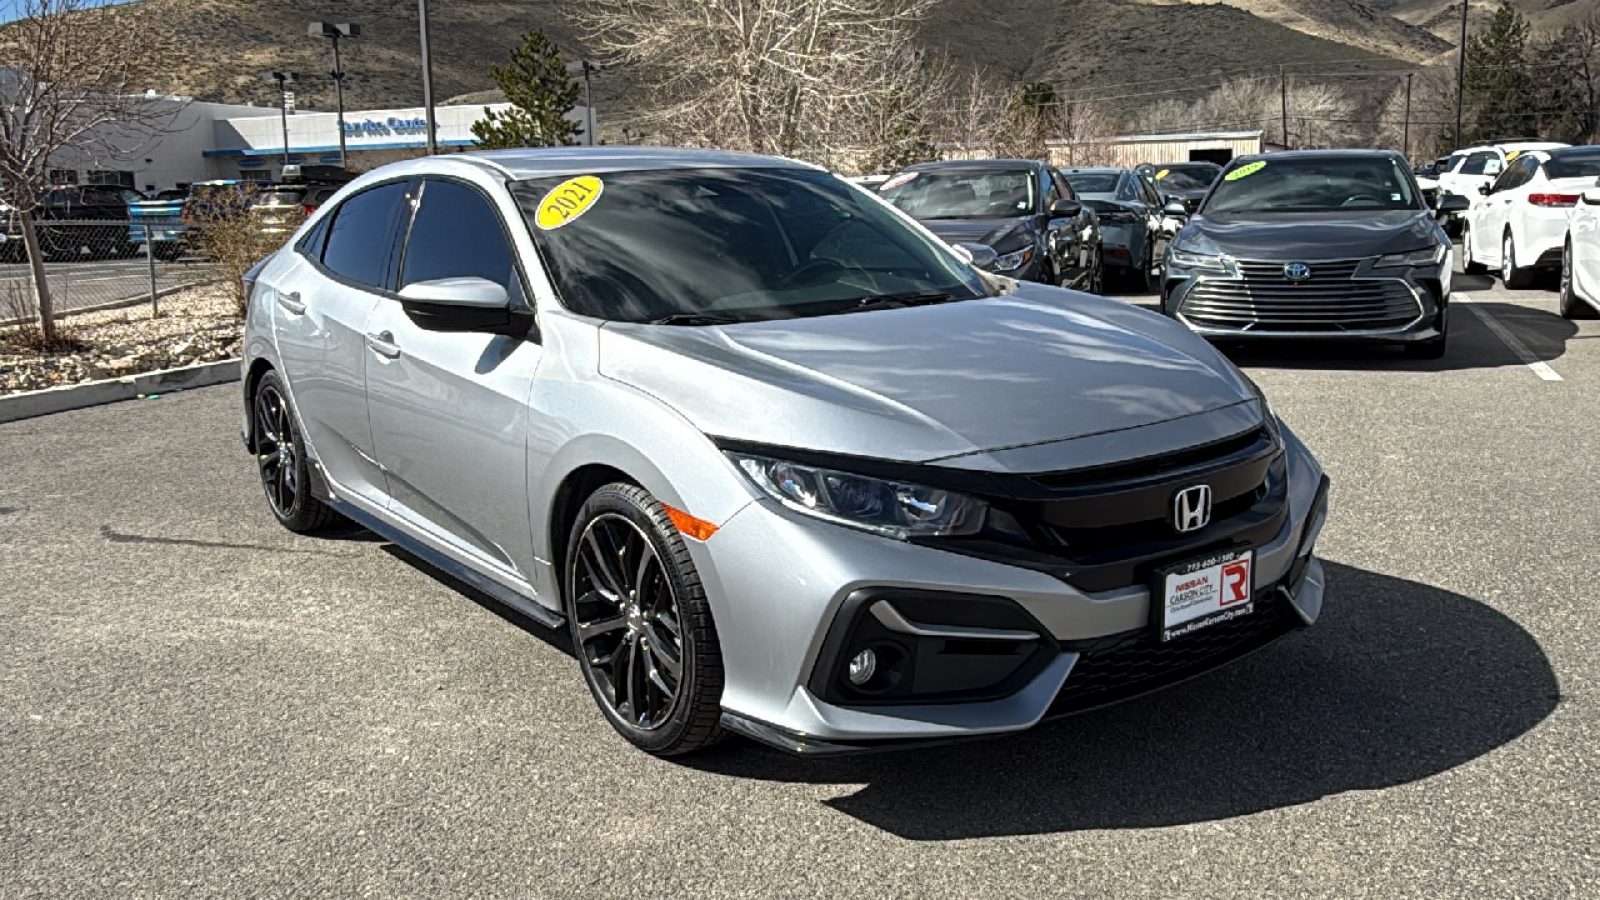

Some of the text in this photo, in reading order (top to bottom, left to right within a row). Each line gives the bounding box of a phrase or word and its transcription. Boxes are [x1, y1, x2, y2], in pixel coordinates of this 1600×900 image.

[387, 116, 433, 130] Cente
[546, 181, 595, 220] 2021
[1175, 576, 1208, 593] NISSAN
[1224, 564, 1248, 601] R
[1170, 589, 1198, 605] CARSON
[1199, 584, 1212, 597] CITY
